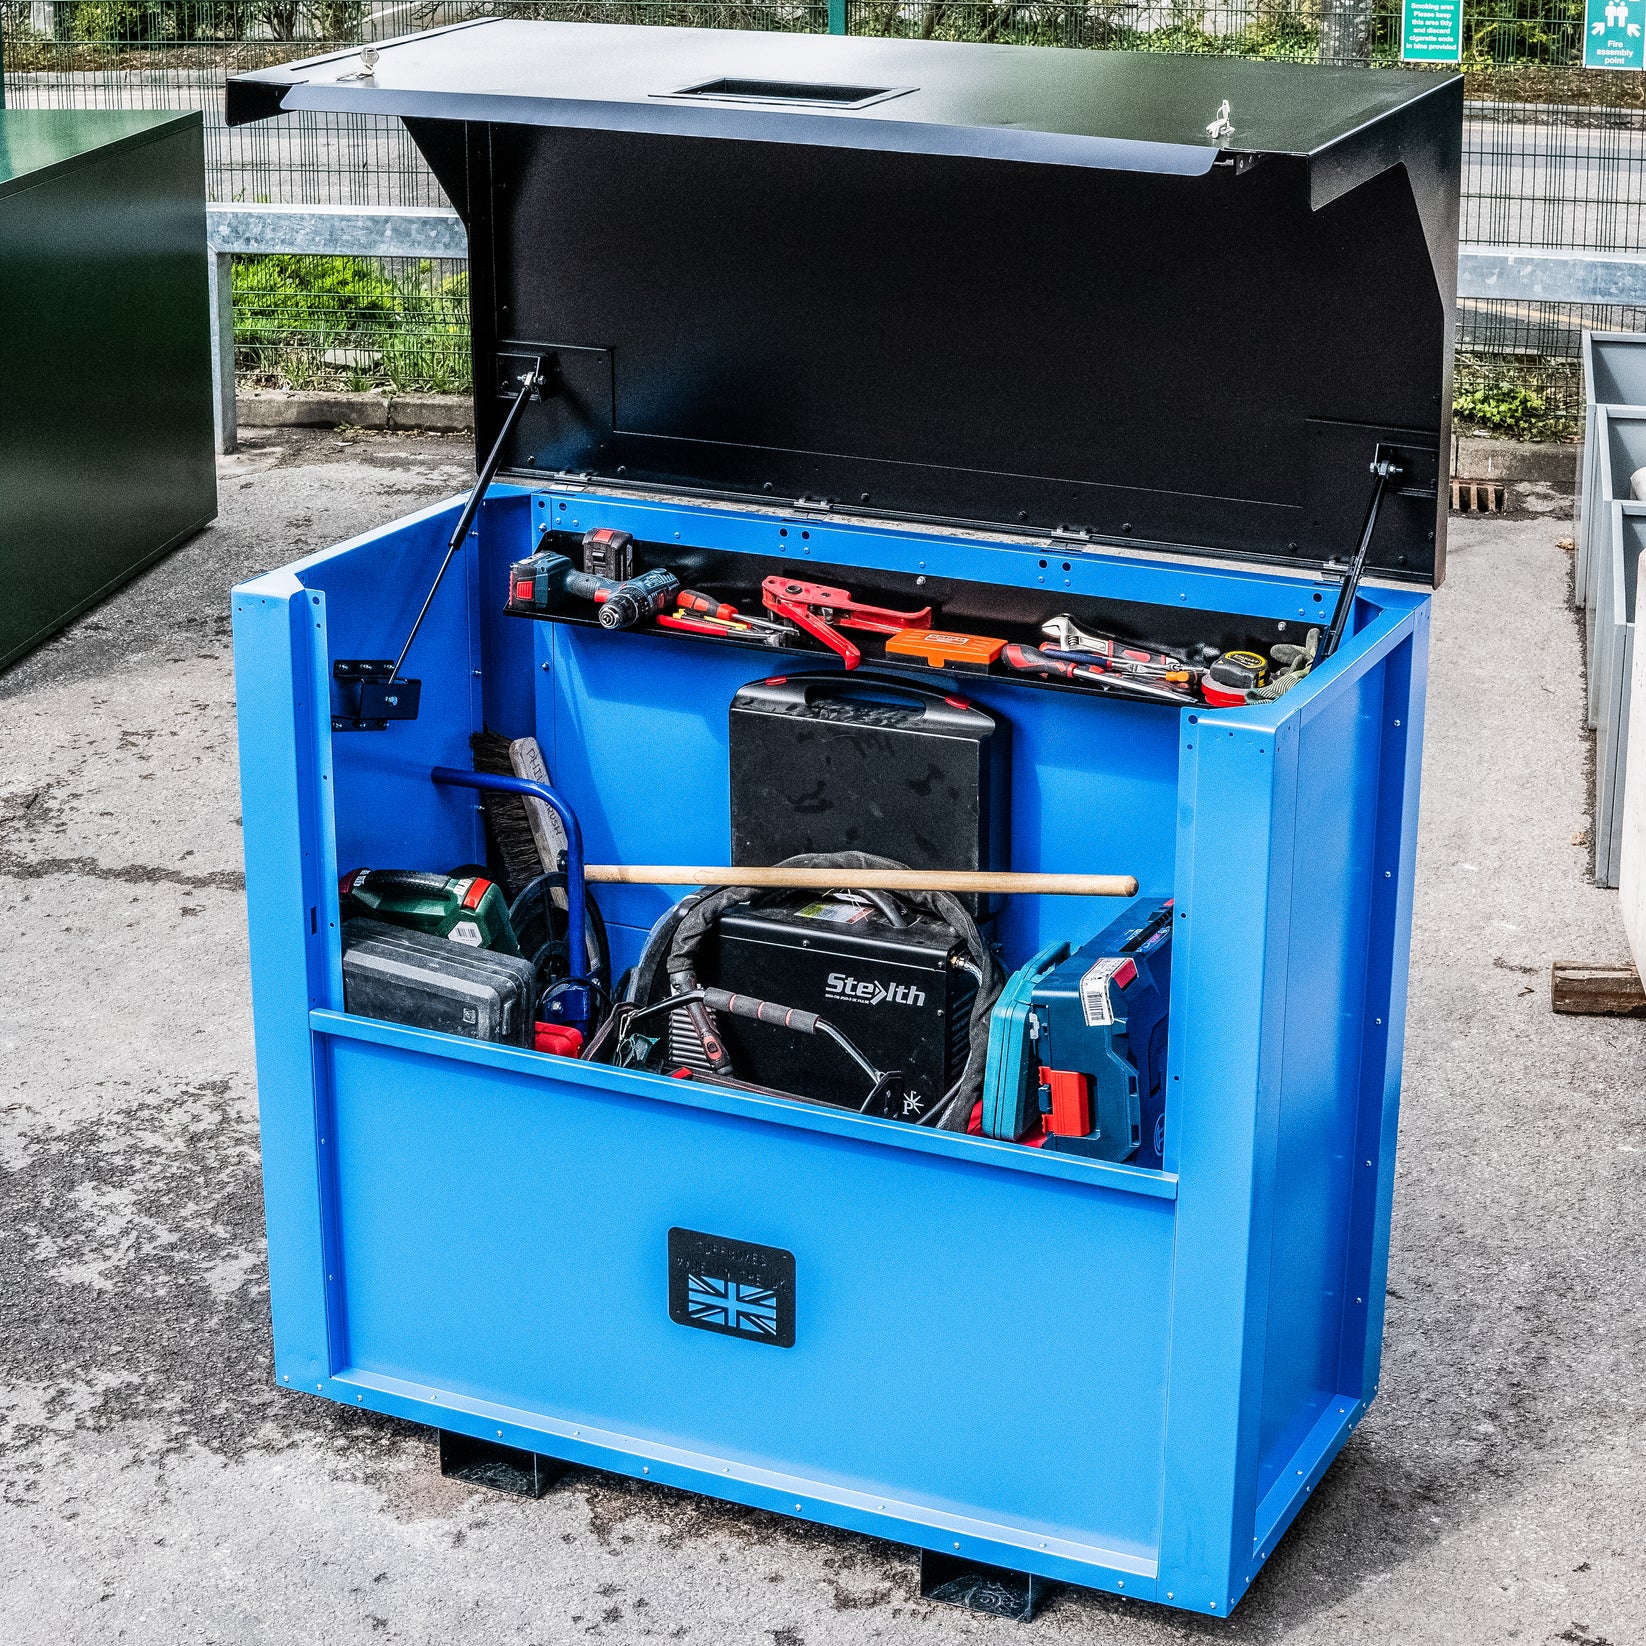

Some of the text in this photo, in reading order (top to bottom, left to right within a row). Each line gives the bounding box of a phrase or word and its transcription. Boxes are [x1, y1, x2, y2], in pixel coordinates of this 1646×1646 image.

[1411, 3, 1439, 11] Smoking
[1607, 40, 1624, 48] Fire
[1596, 49, 1634, 58] assembly
[1604, 57, 1625, 65] point
